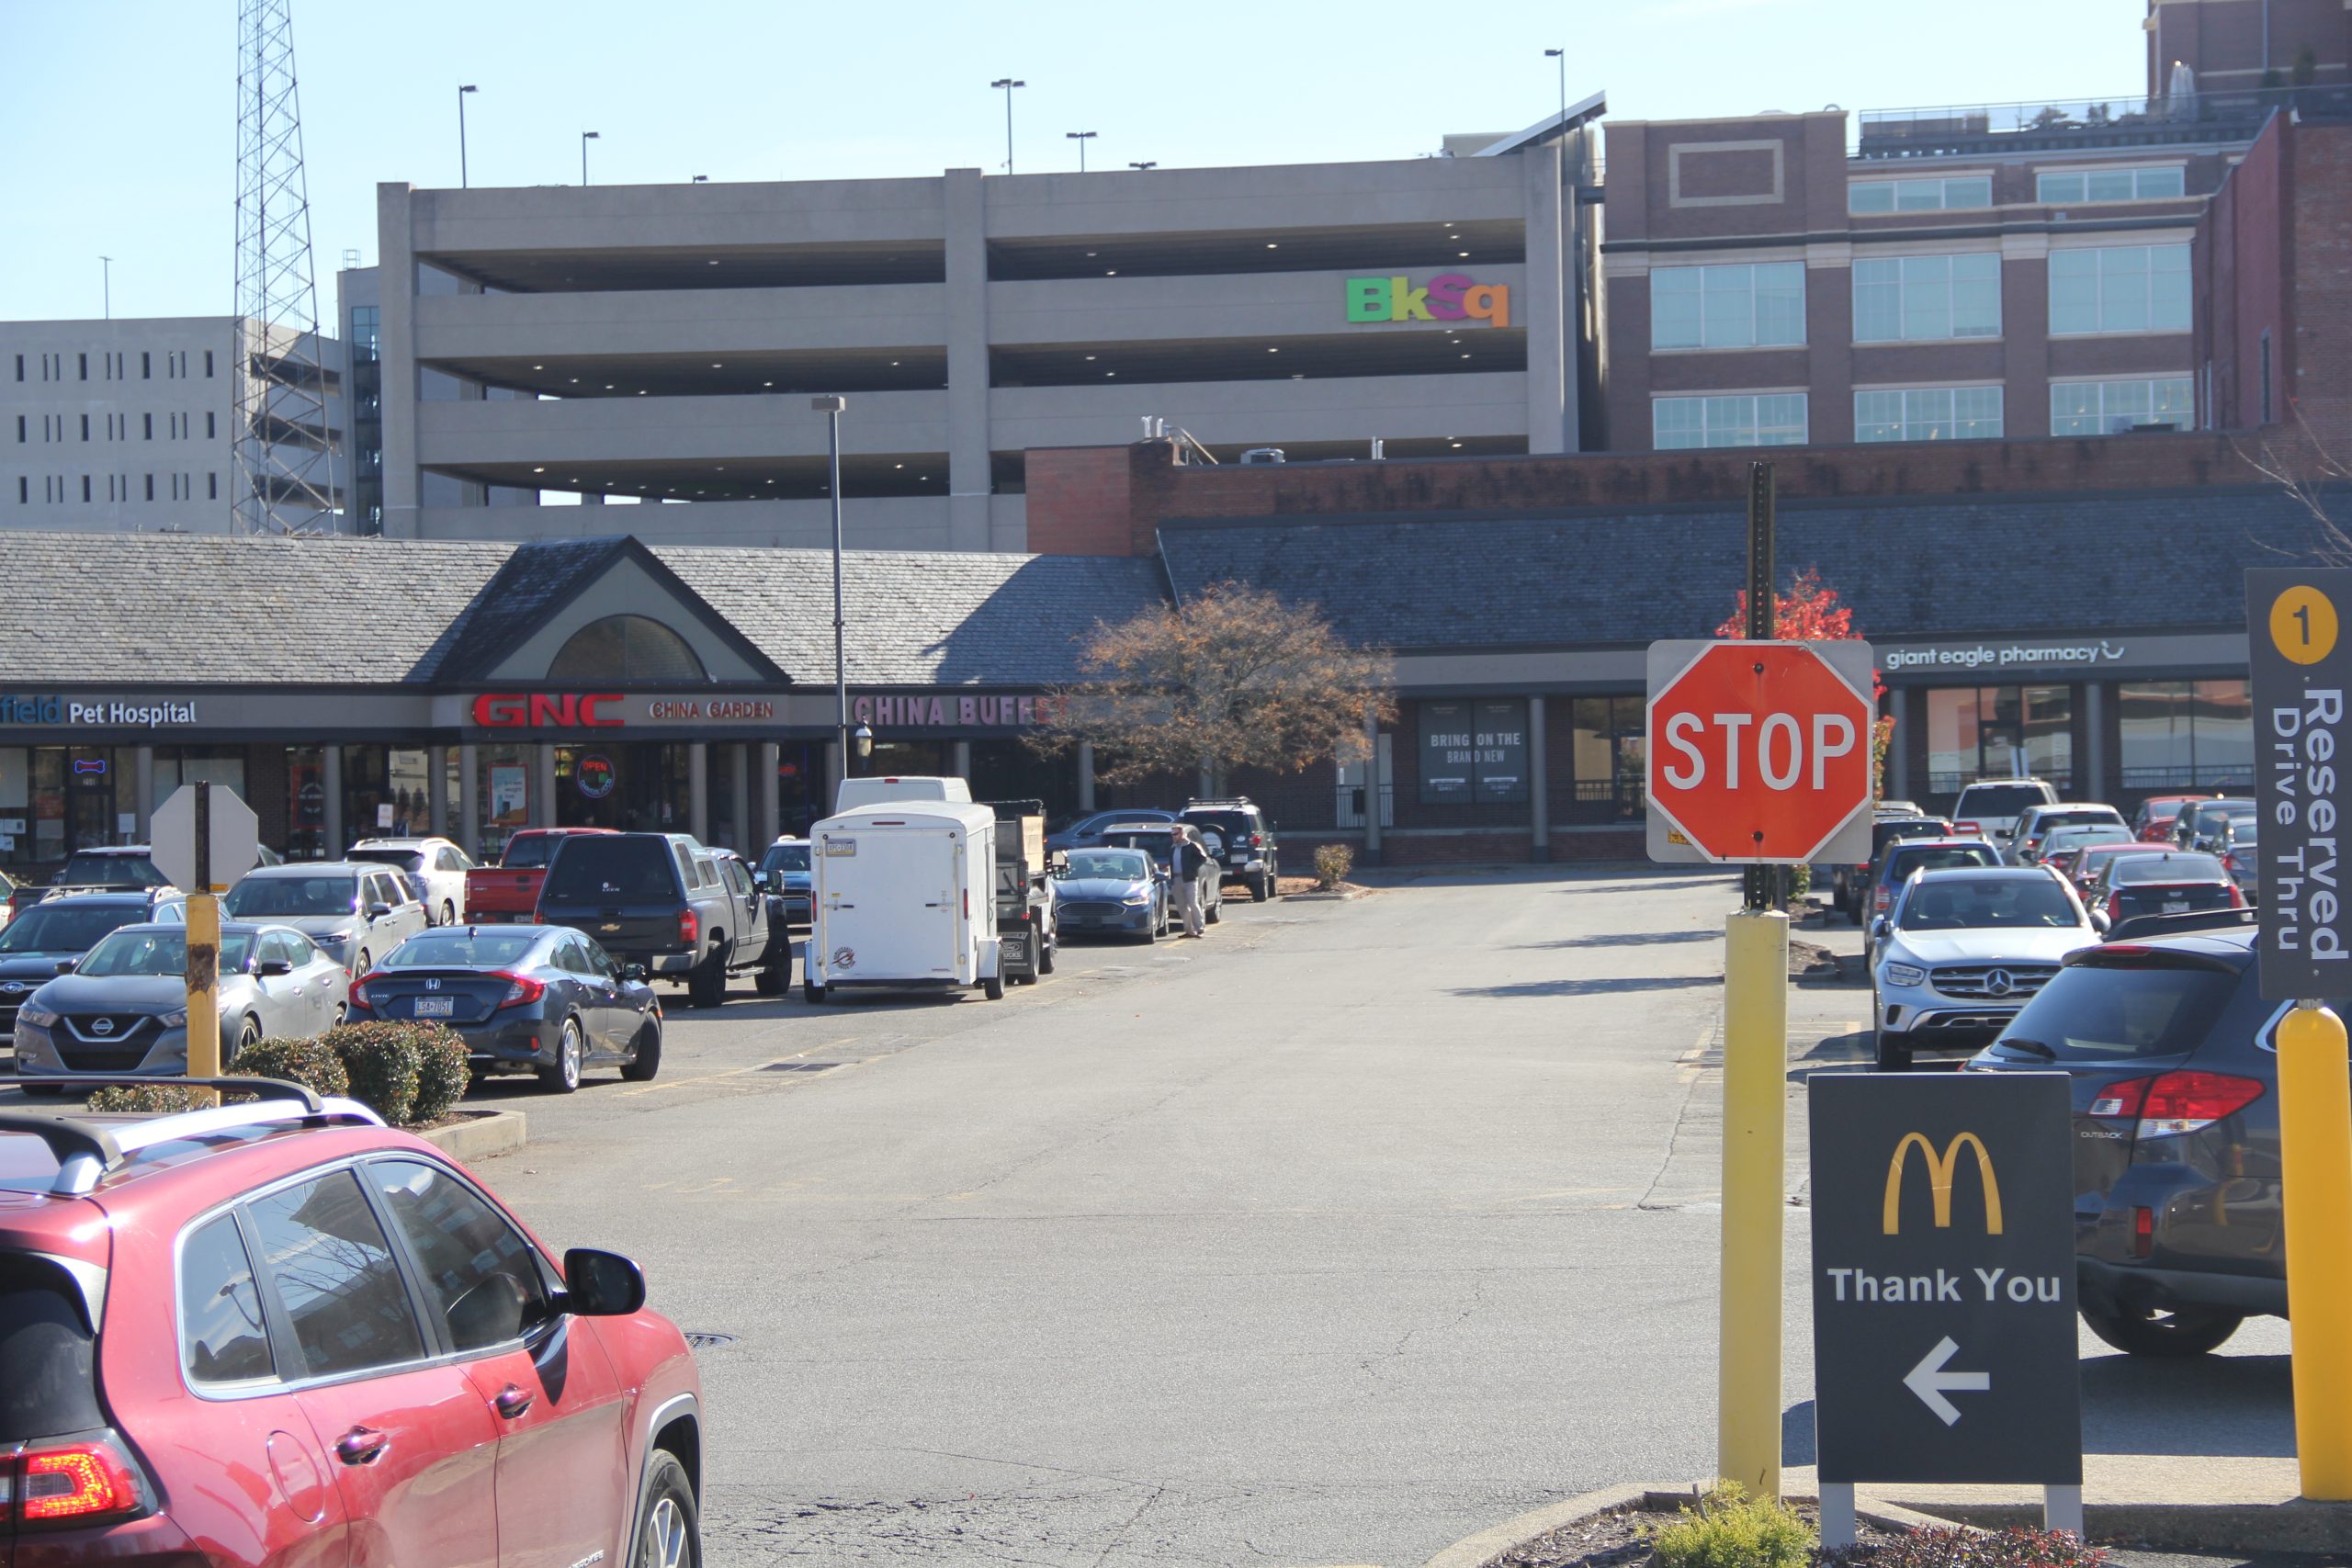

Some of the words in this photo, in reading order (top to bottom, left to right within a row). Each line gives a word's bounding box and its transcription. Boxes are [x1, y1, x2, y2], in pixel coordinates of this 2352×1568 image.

[1347, 273, 1509, 329] BkSq
[2293, 605, 2310, 645] 1
[1886, 649, 1938, 671] giant
[1939, 646, 1996, 668] eagle
[1999, 646, 2098, 665] pharmacy
[69, 703, 105, 724] Pet
[109, 701, 197, 728] Hospital
[472, 694, 625, 727] GNC
[649, 701, 699, 719] CHINA
[707, 701, 774, 719] GARDEN
[854, 695, 943, 725] CHINA
[1430, 733, 1470, 747] BRING
[1476, 733, 1494, 746] ON
[1497, 732, 1521, 745] THE
[1663, 712, 1856, 791] STOP
[582, 761, 608, 772] OPEN
[1484, 750, 1505, 762] NEW
[2273, 708, 2302, 825] Drive
[2304, 690, 2350, 959] Reserved
[2277, 846, 2304, 950] Thru
[2080, 1131, 2123, 1139] OUTBACK
[1826, 1268, 1962, 1302] Thank
[1973, 1268, 2061, 1303] You
